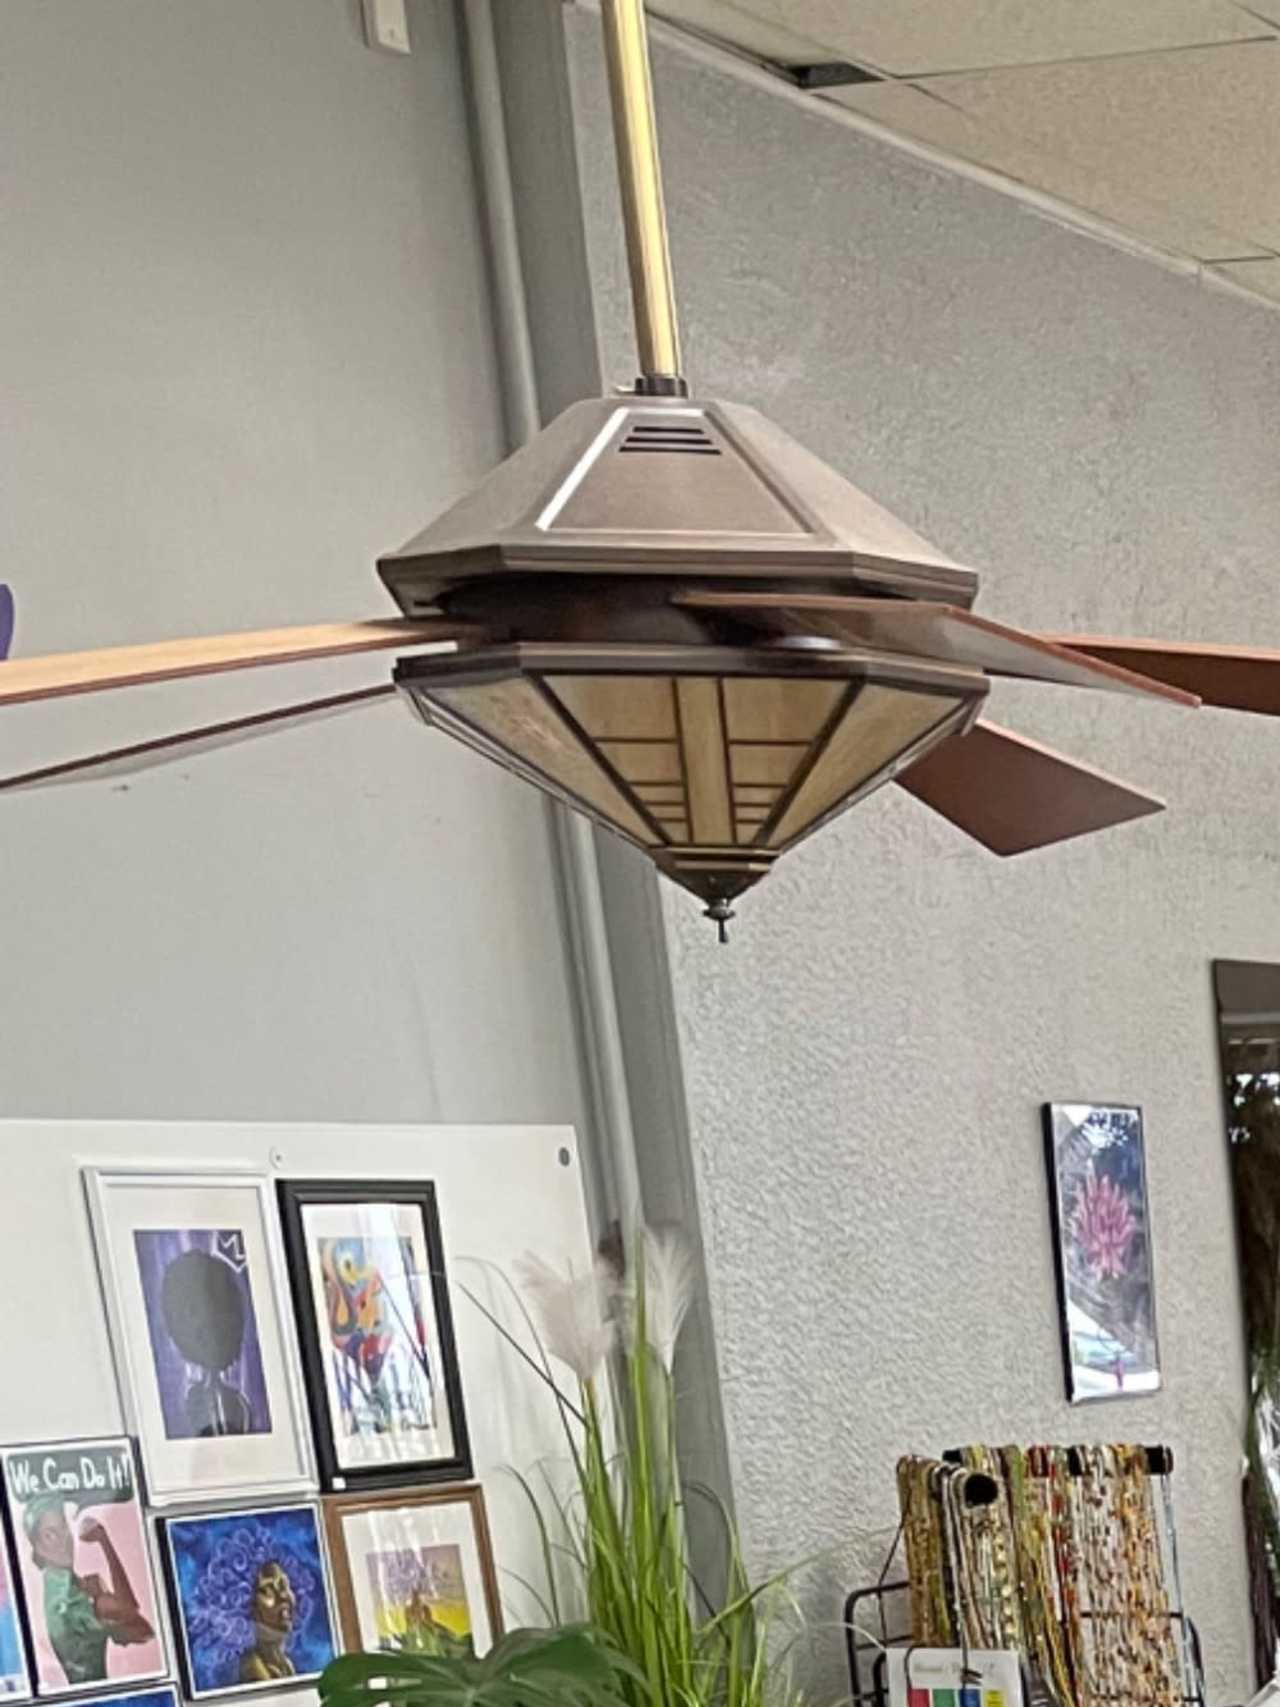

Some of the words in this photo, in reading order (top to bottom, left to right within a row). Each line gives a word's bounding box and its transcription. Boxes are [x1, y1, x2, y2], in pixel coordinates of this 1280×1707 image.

[8, 1459, 41, 1496] We
[43, 1456, 80, 1491] Can
[80, 1455, 106, 1489] Do
